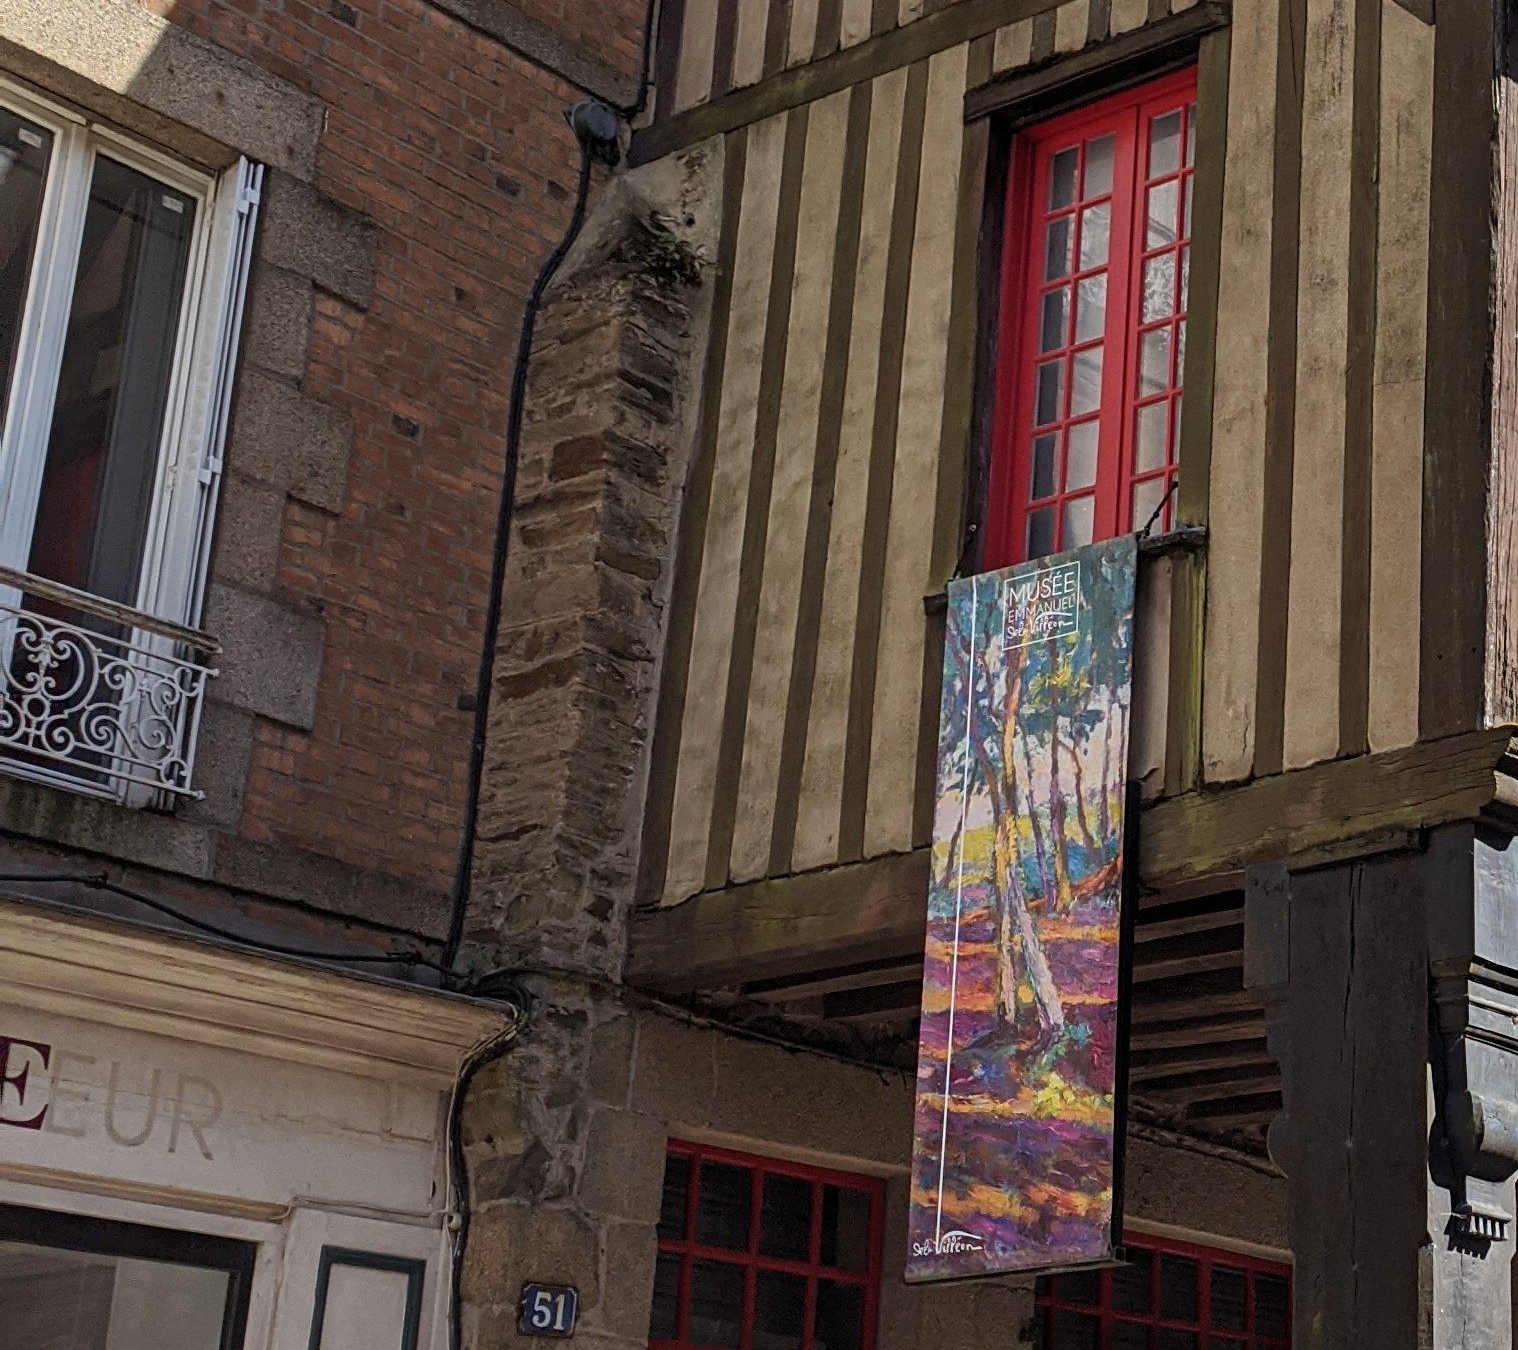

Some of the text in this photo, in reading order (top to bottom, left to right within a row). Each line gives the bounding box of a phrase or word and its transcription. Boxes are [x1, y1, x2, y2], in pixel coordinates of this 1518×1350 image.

[1009, 571, 1075, 607] MUSÉE
[1007, 596, 1074, 624] EMMANUEL
[532, 1291, 565, 1331] 51
